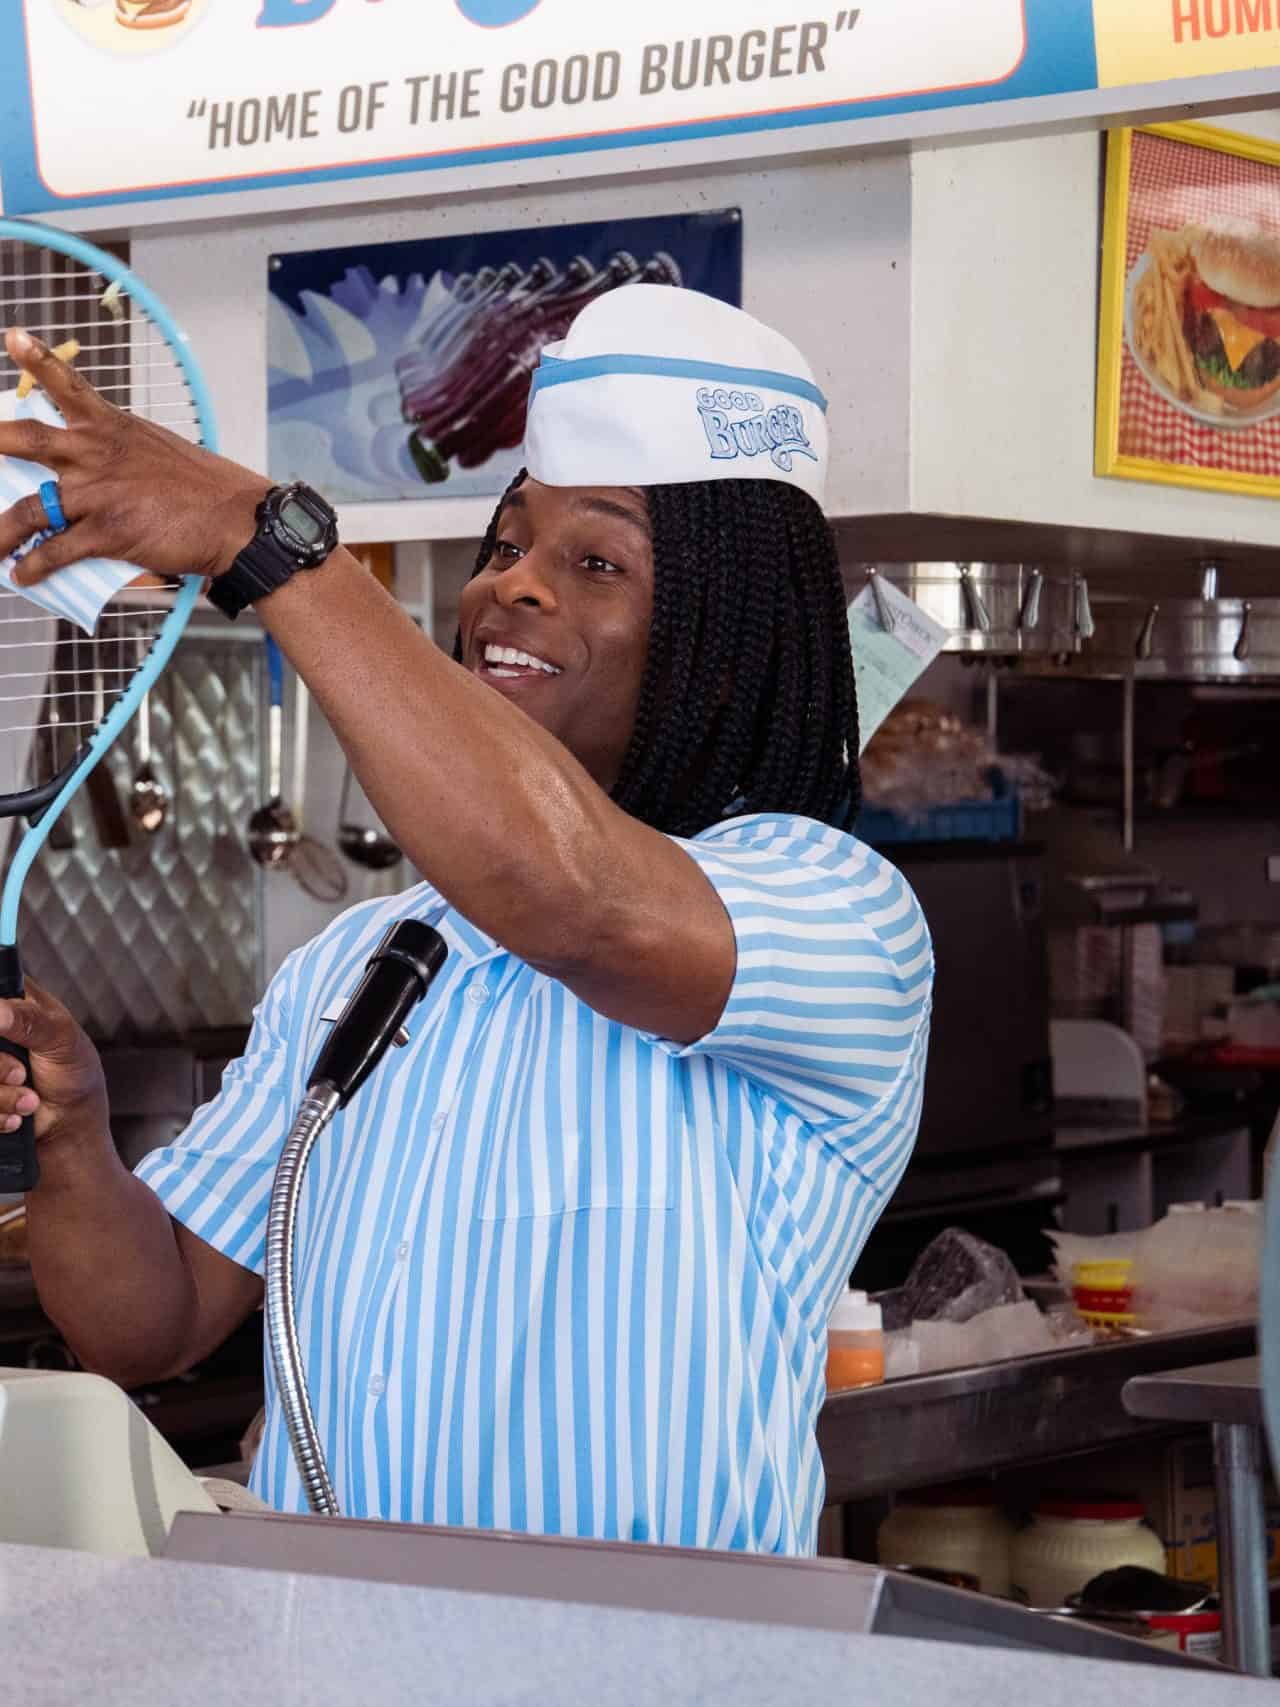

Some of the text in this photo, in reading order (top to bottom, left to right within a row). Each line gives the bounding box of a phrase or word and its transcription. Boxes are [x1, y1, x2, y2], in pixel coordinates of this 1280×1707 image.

[1172, 0, 1280, 43] HOM
[337, 80, 390, 134] OF
[404, 68, 486, 126] THE
[500, 50, 621, 114] GOOD
[696, 387, 764, 412] GOOD
